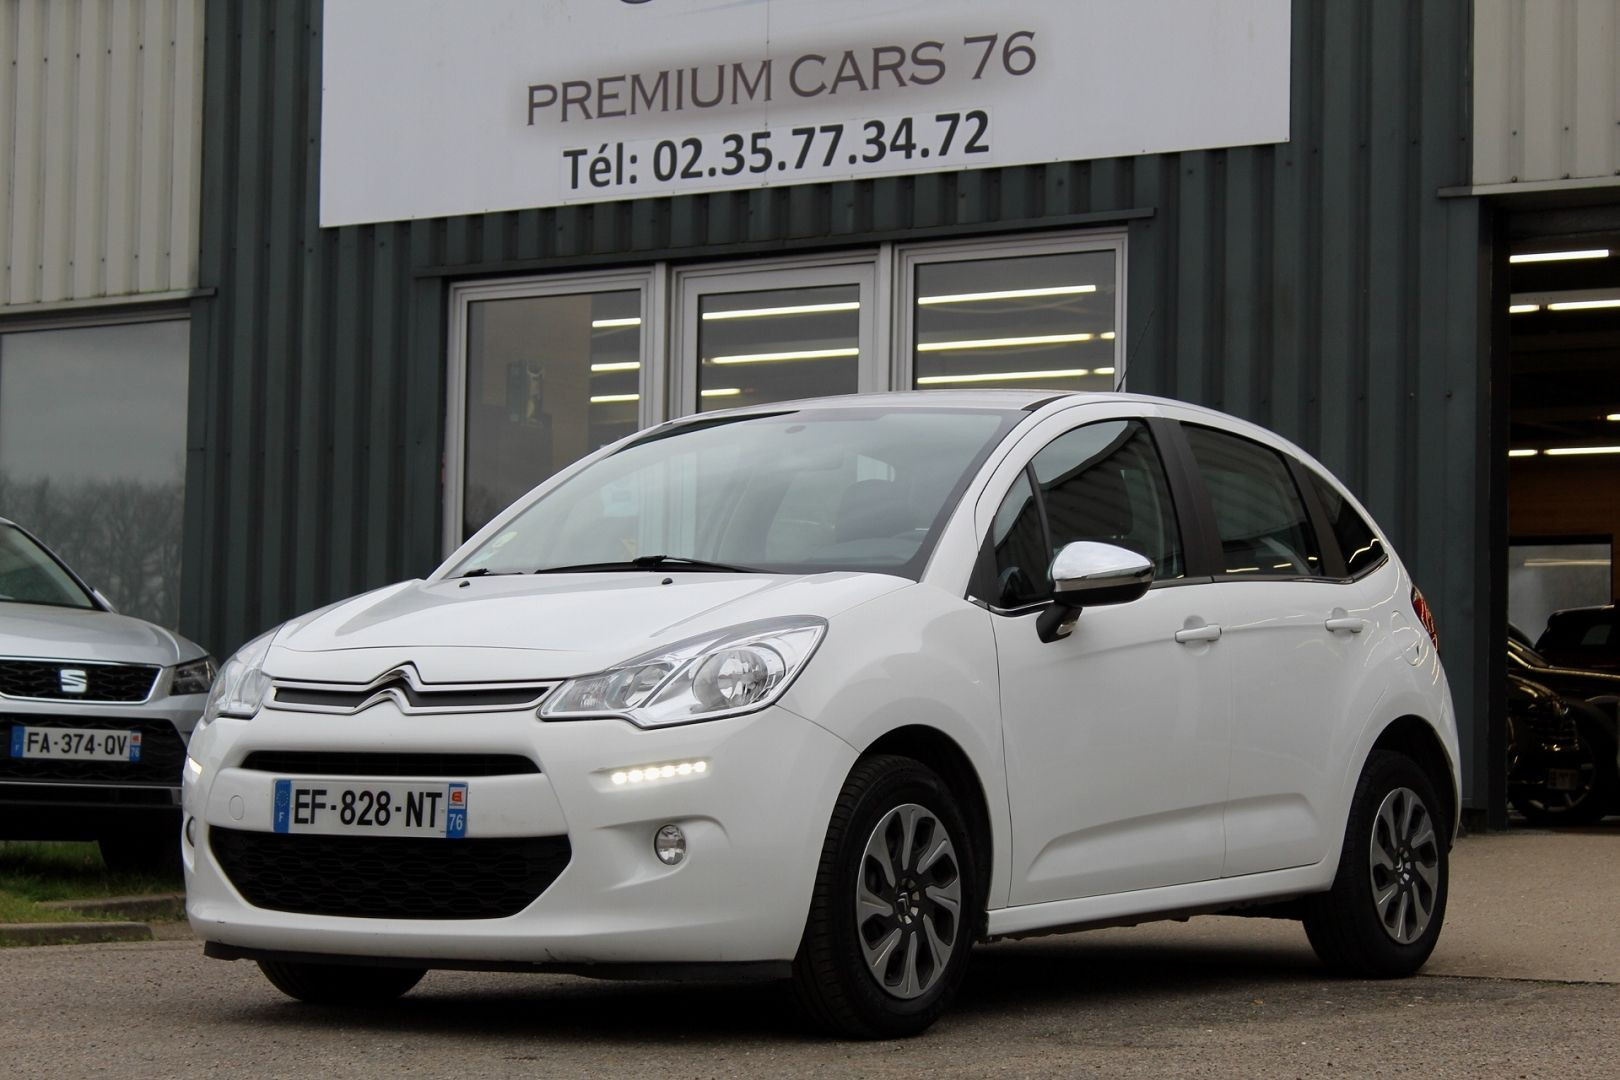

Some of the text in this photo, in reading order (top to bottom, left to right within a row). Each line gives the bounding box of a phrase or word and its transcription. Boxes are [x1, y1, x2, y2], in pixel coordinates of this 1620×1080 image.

[527, 30, 1037, 126] PREMIUM CARS 76
[563, 109, 990, 190] Tél: 02.35.77.34.72
[27, 732, 128, 756] FA-374-QV
[278, 811, 285, 822] F
[294, 789, 443, 828] EF-828-NT
[448, 813, 463, 831] 76
